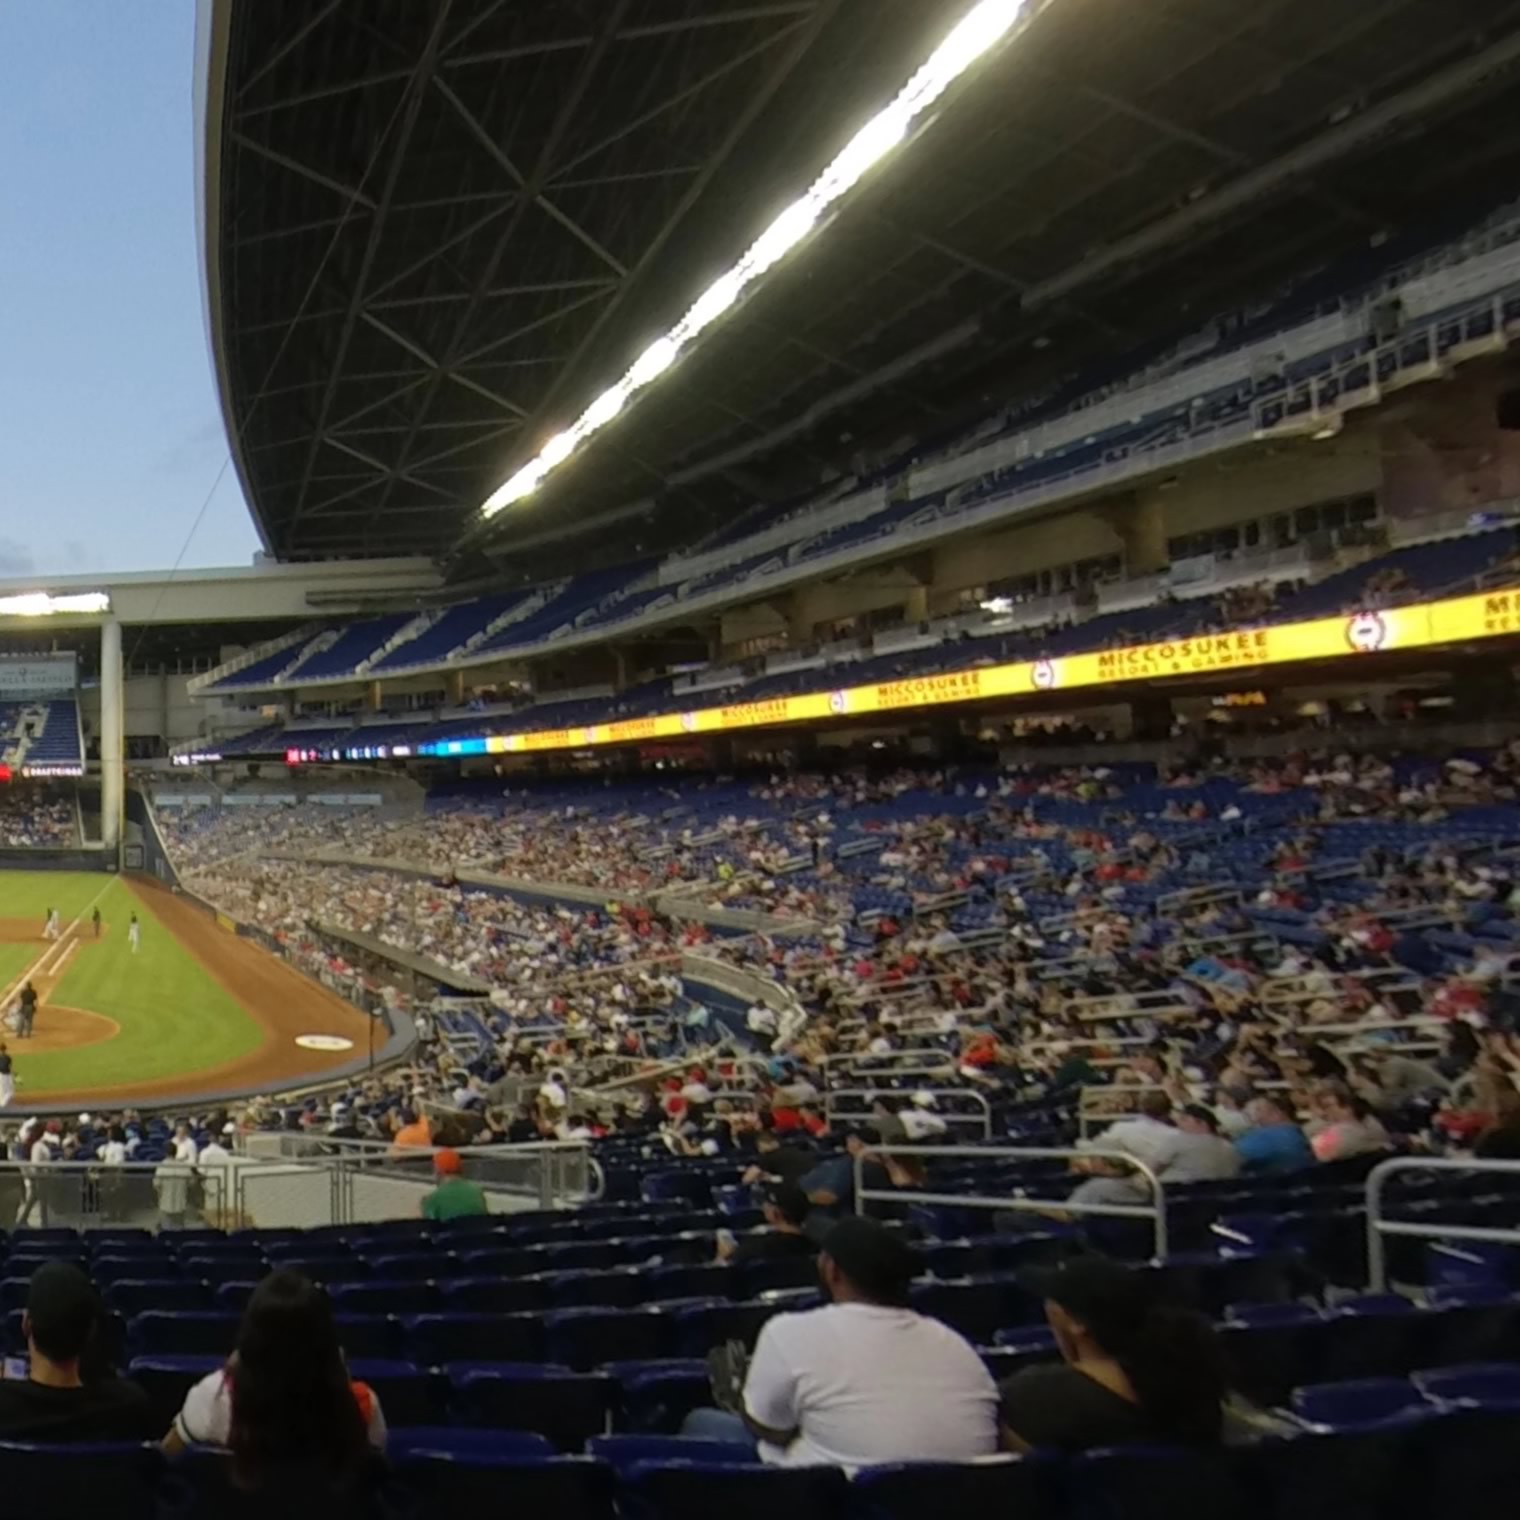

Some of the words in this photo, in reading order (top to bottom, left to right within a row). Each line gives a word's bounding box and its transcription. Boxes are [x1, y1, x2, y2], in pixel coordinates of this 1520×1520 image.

[1098, 632, 1267, 667] MICCOSUKEE
[1098, 662, 1160, 679] RESORT
[1191, 650, 1268, 668] GAMING
[878, 672, 979, 696] MICCOSUKEE
